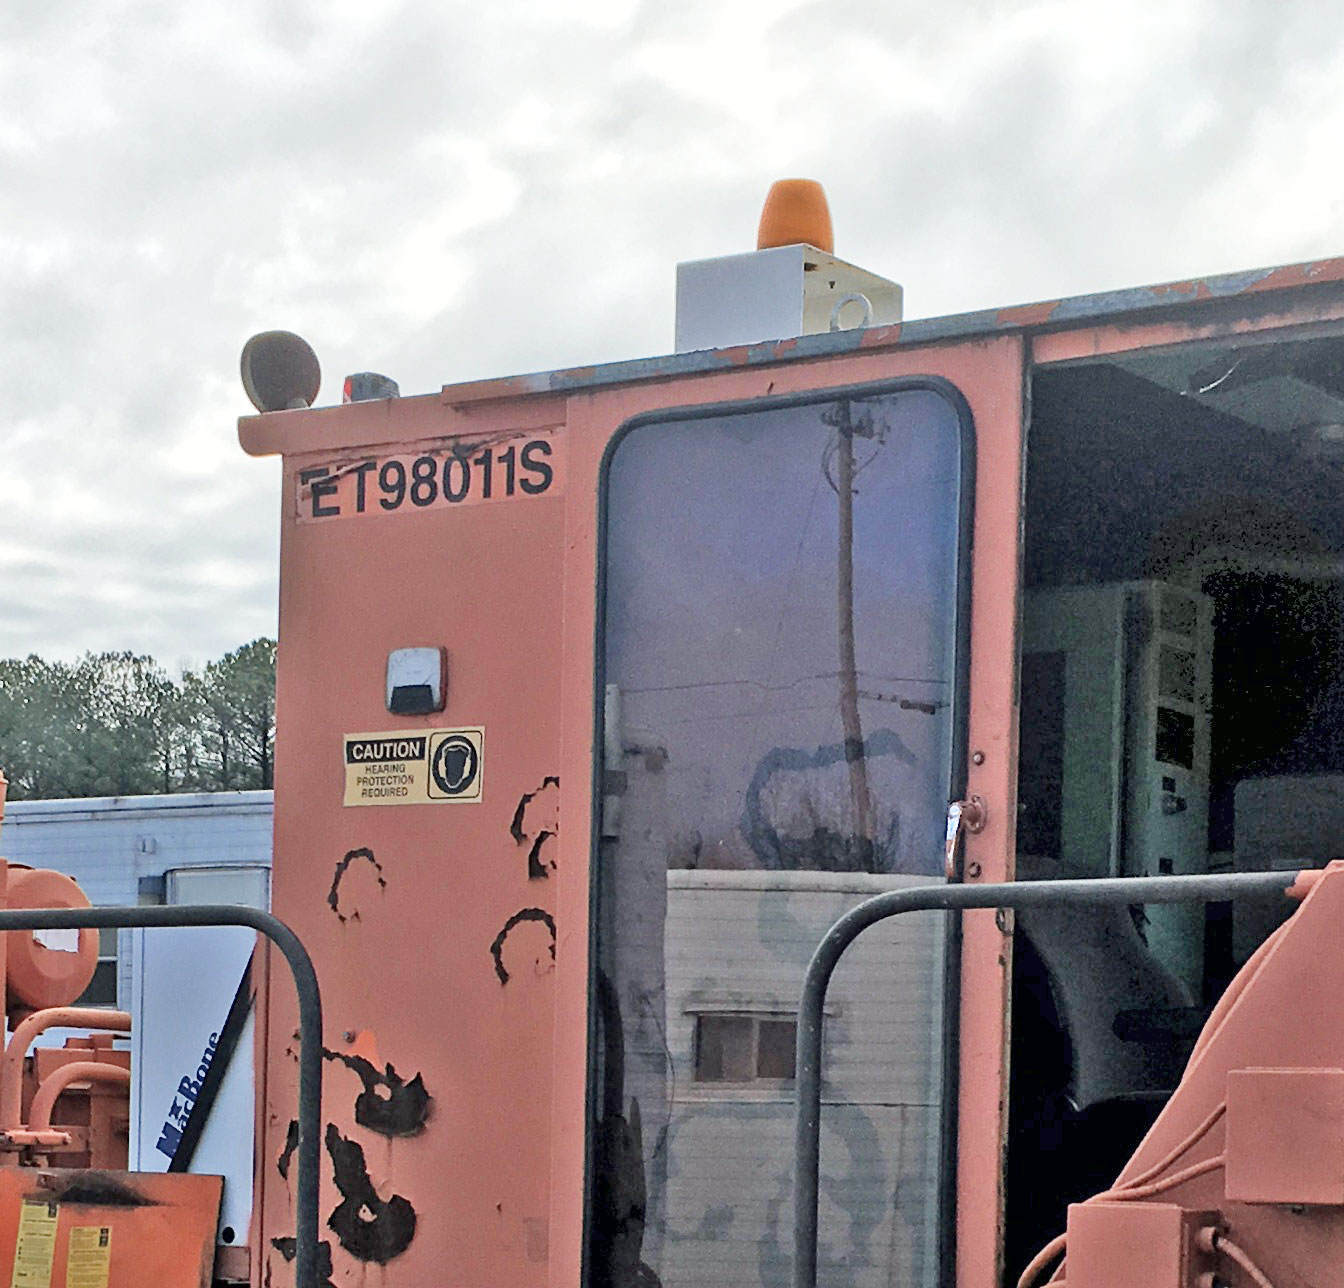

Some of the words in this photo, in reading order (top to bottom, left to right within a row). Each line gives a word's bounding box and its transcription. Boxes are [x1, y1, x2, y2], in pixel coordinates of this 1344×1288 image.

[299, 440, 554, 518] ET98011S
[351, 741, 421, 761] CAUTION
[365, 763, 406, 775] HEARING
[356, 774, 415, 787] PROTECTION
[361, 786, 409, 799] REQUIRED
